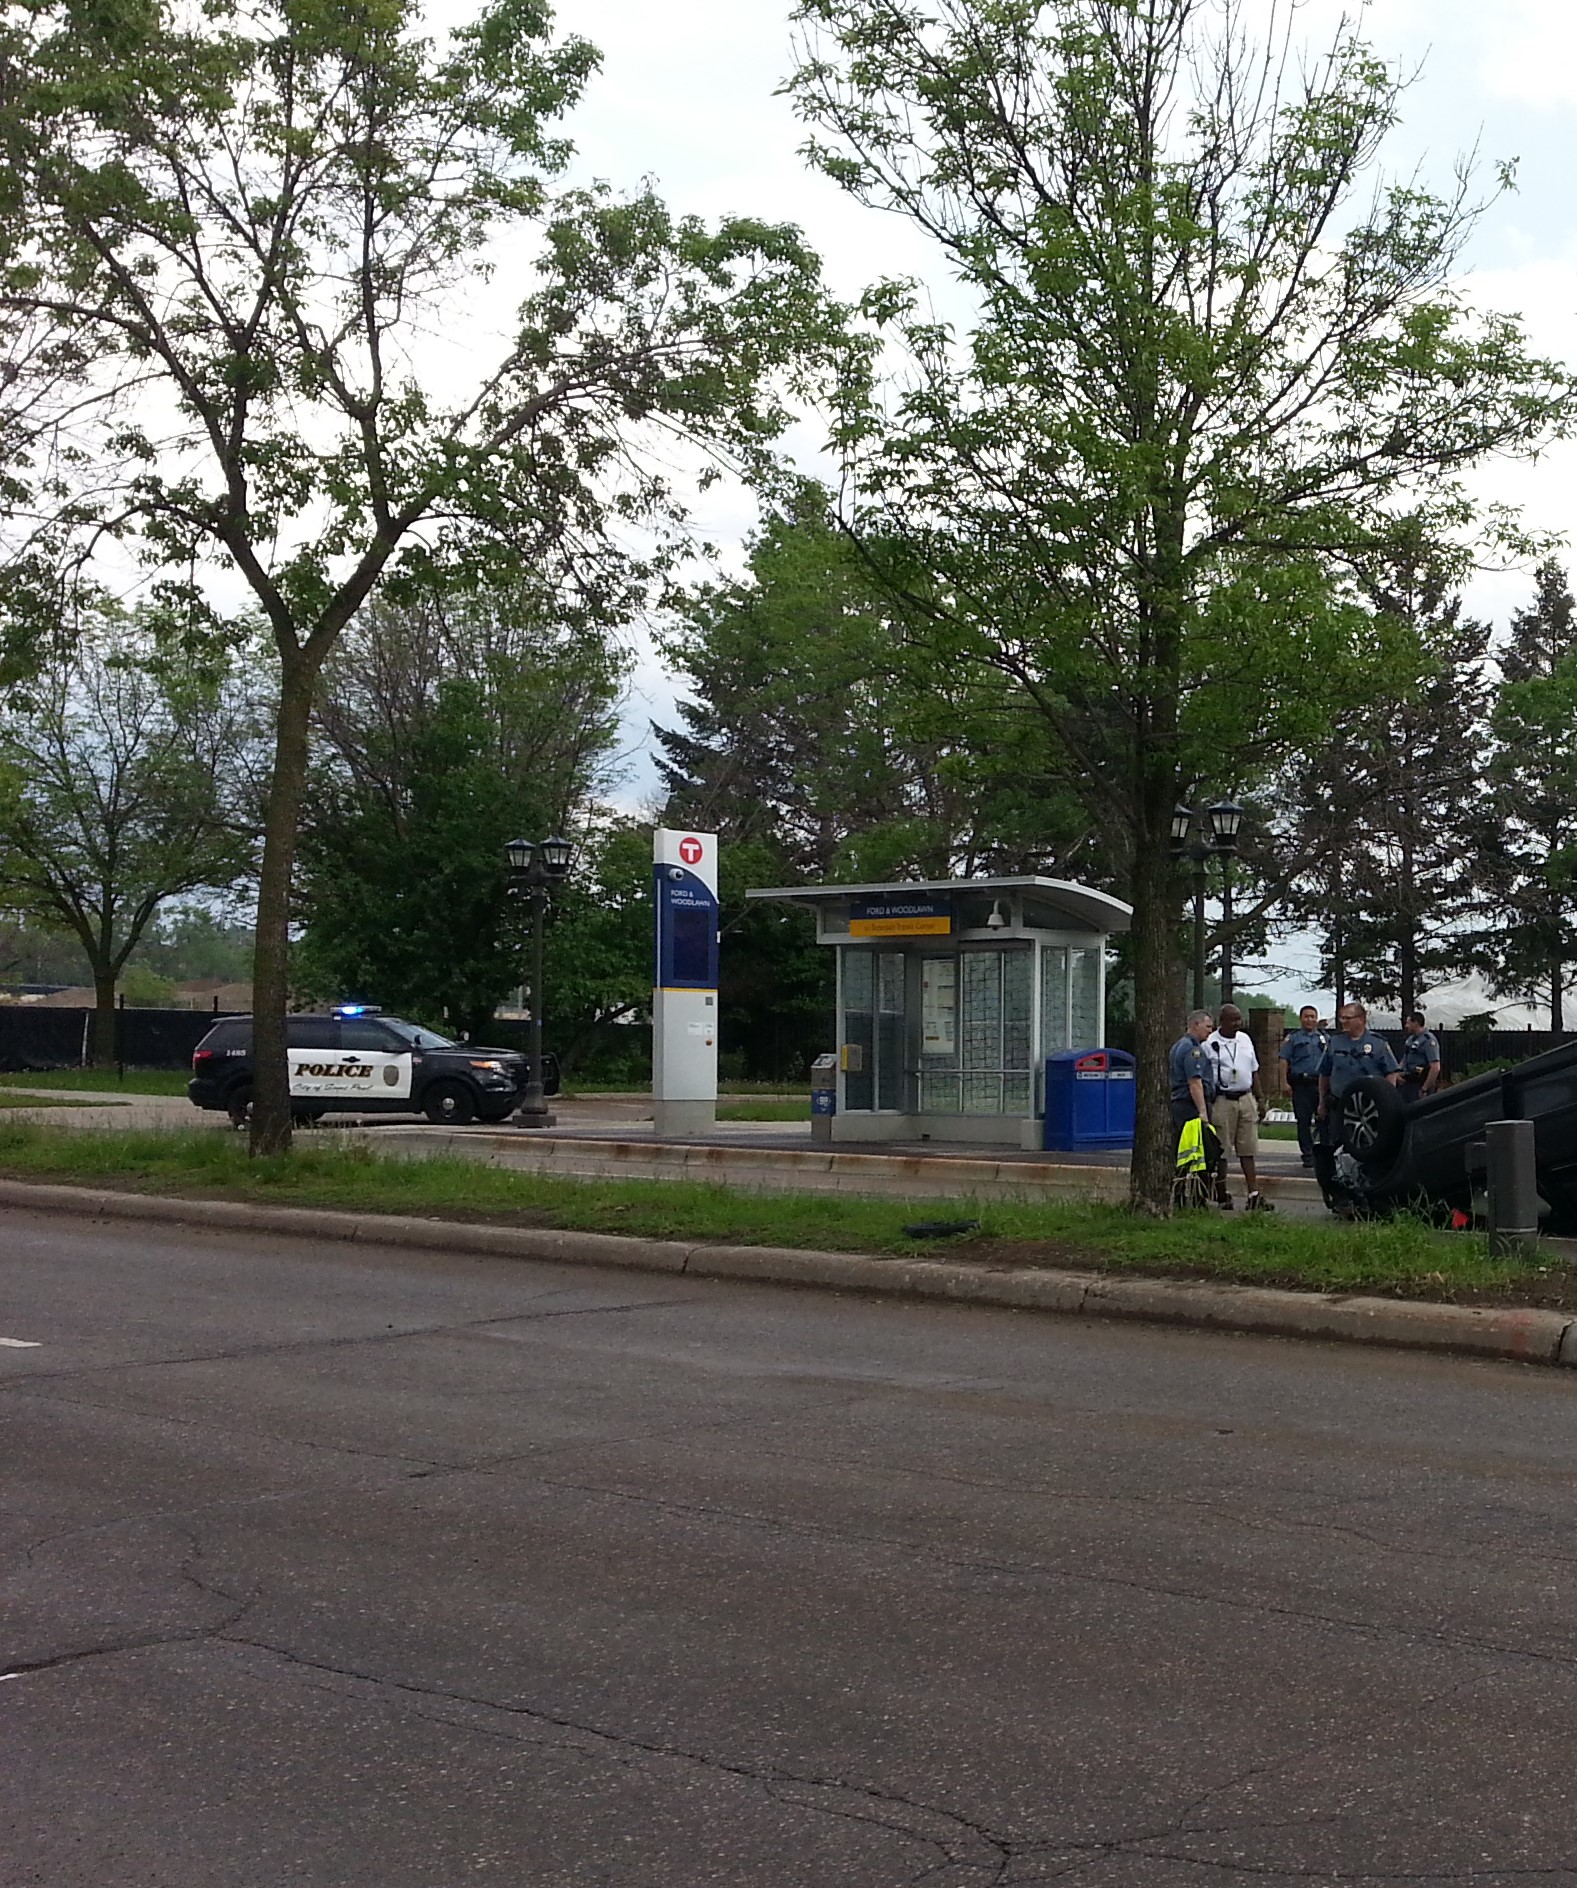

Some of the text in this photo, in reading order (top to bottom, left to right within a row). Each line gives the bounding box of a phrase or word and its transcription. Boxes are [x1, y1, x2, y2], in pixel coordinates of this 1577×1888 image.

[682, 843, 700, 862] T
[670, 889, 688, 897] FORD
[670, 898, 711, 907] WOODLAWN
[866, 907, 885, 915] FORD
[891, 905, 934, 914] WOODLAWN
[294, 1063, 374, 1078] POLICE
